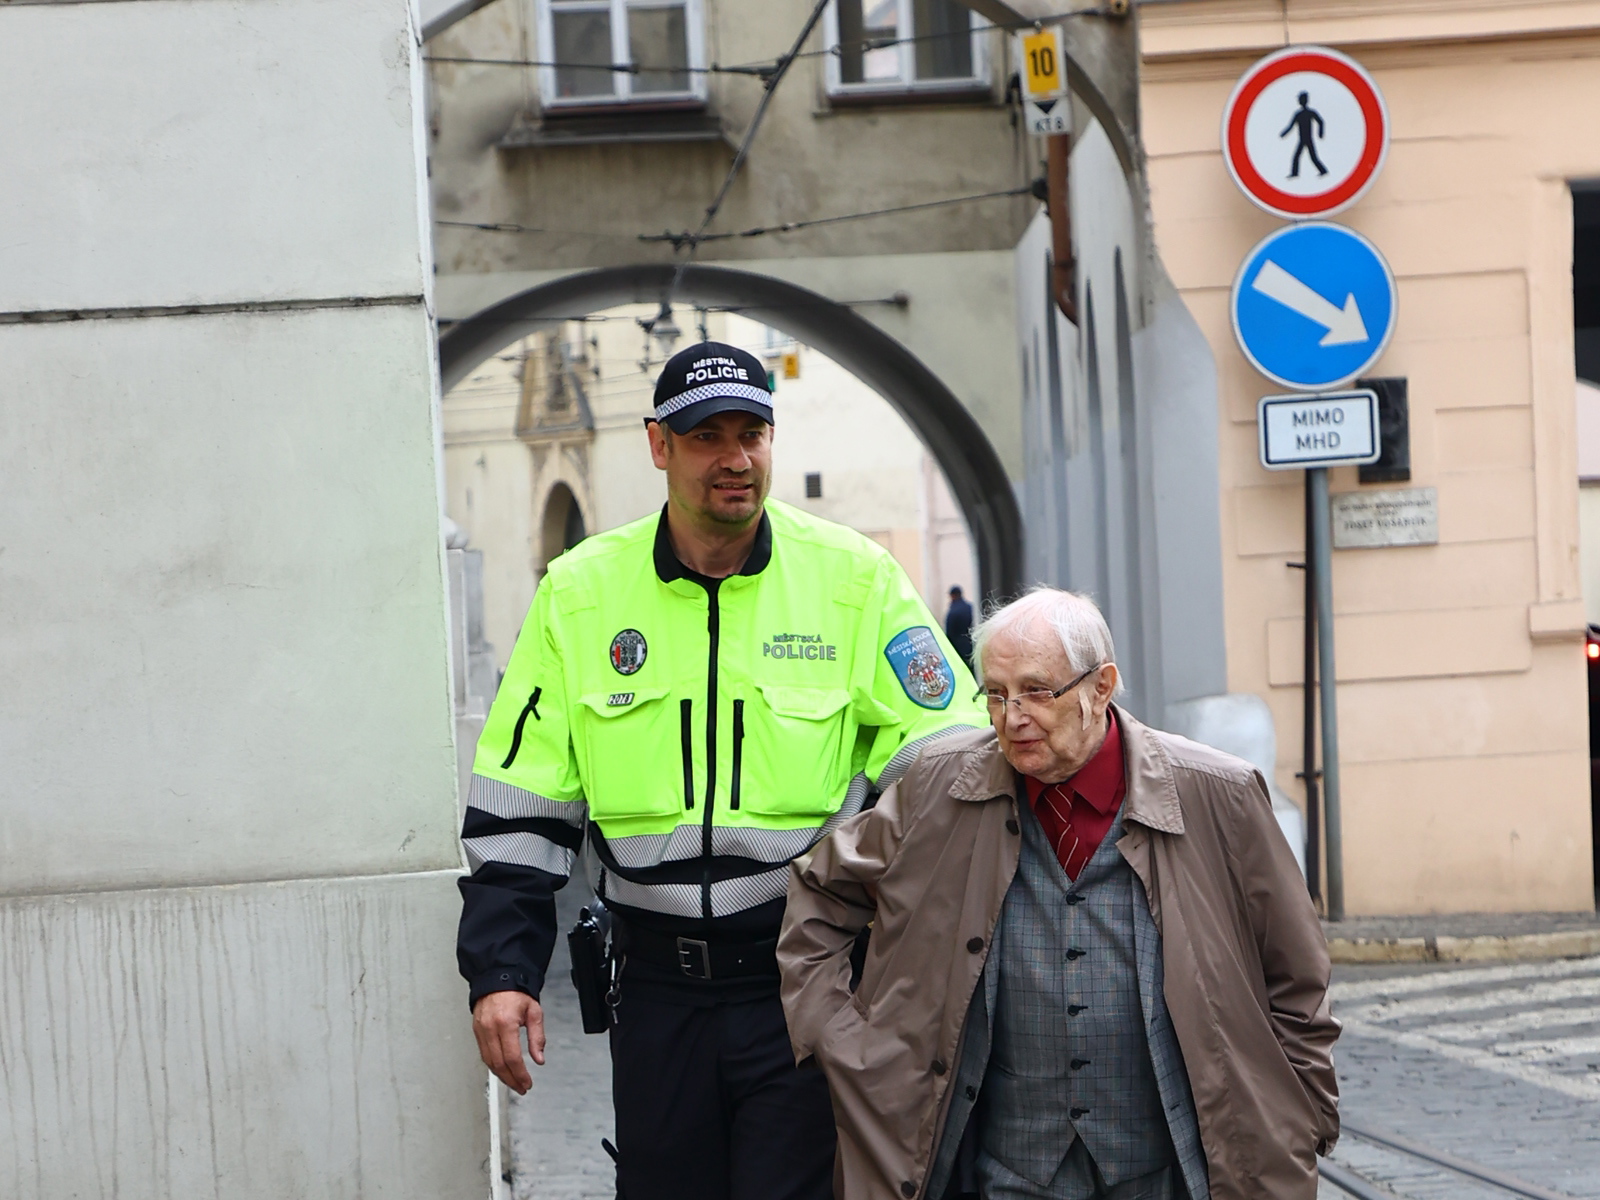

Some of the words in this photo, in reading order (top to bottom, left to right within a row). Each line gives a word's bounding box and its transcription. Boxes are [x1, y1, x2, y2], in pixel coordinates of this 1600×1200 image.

[1030, 47, 1055, 76] 10
[686, 366, 749, 384] POLICIE
[1292, 407, 1344, 427] MIMO
[1296, 431, 1341, 450] MHD
[763, 642, 836, 661] POLICIE
[902, 641, 928, 657] PRAHA
